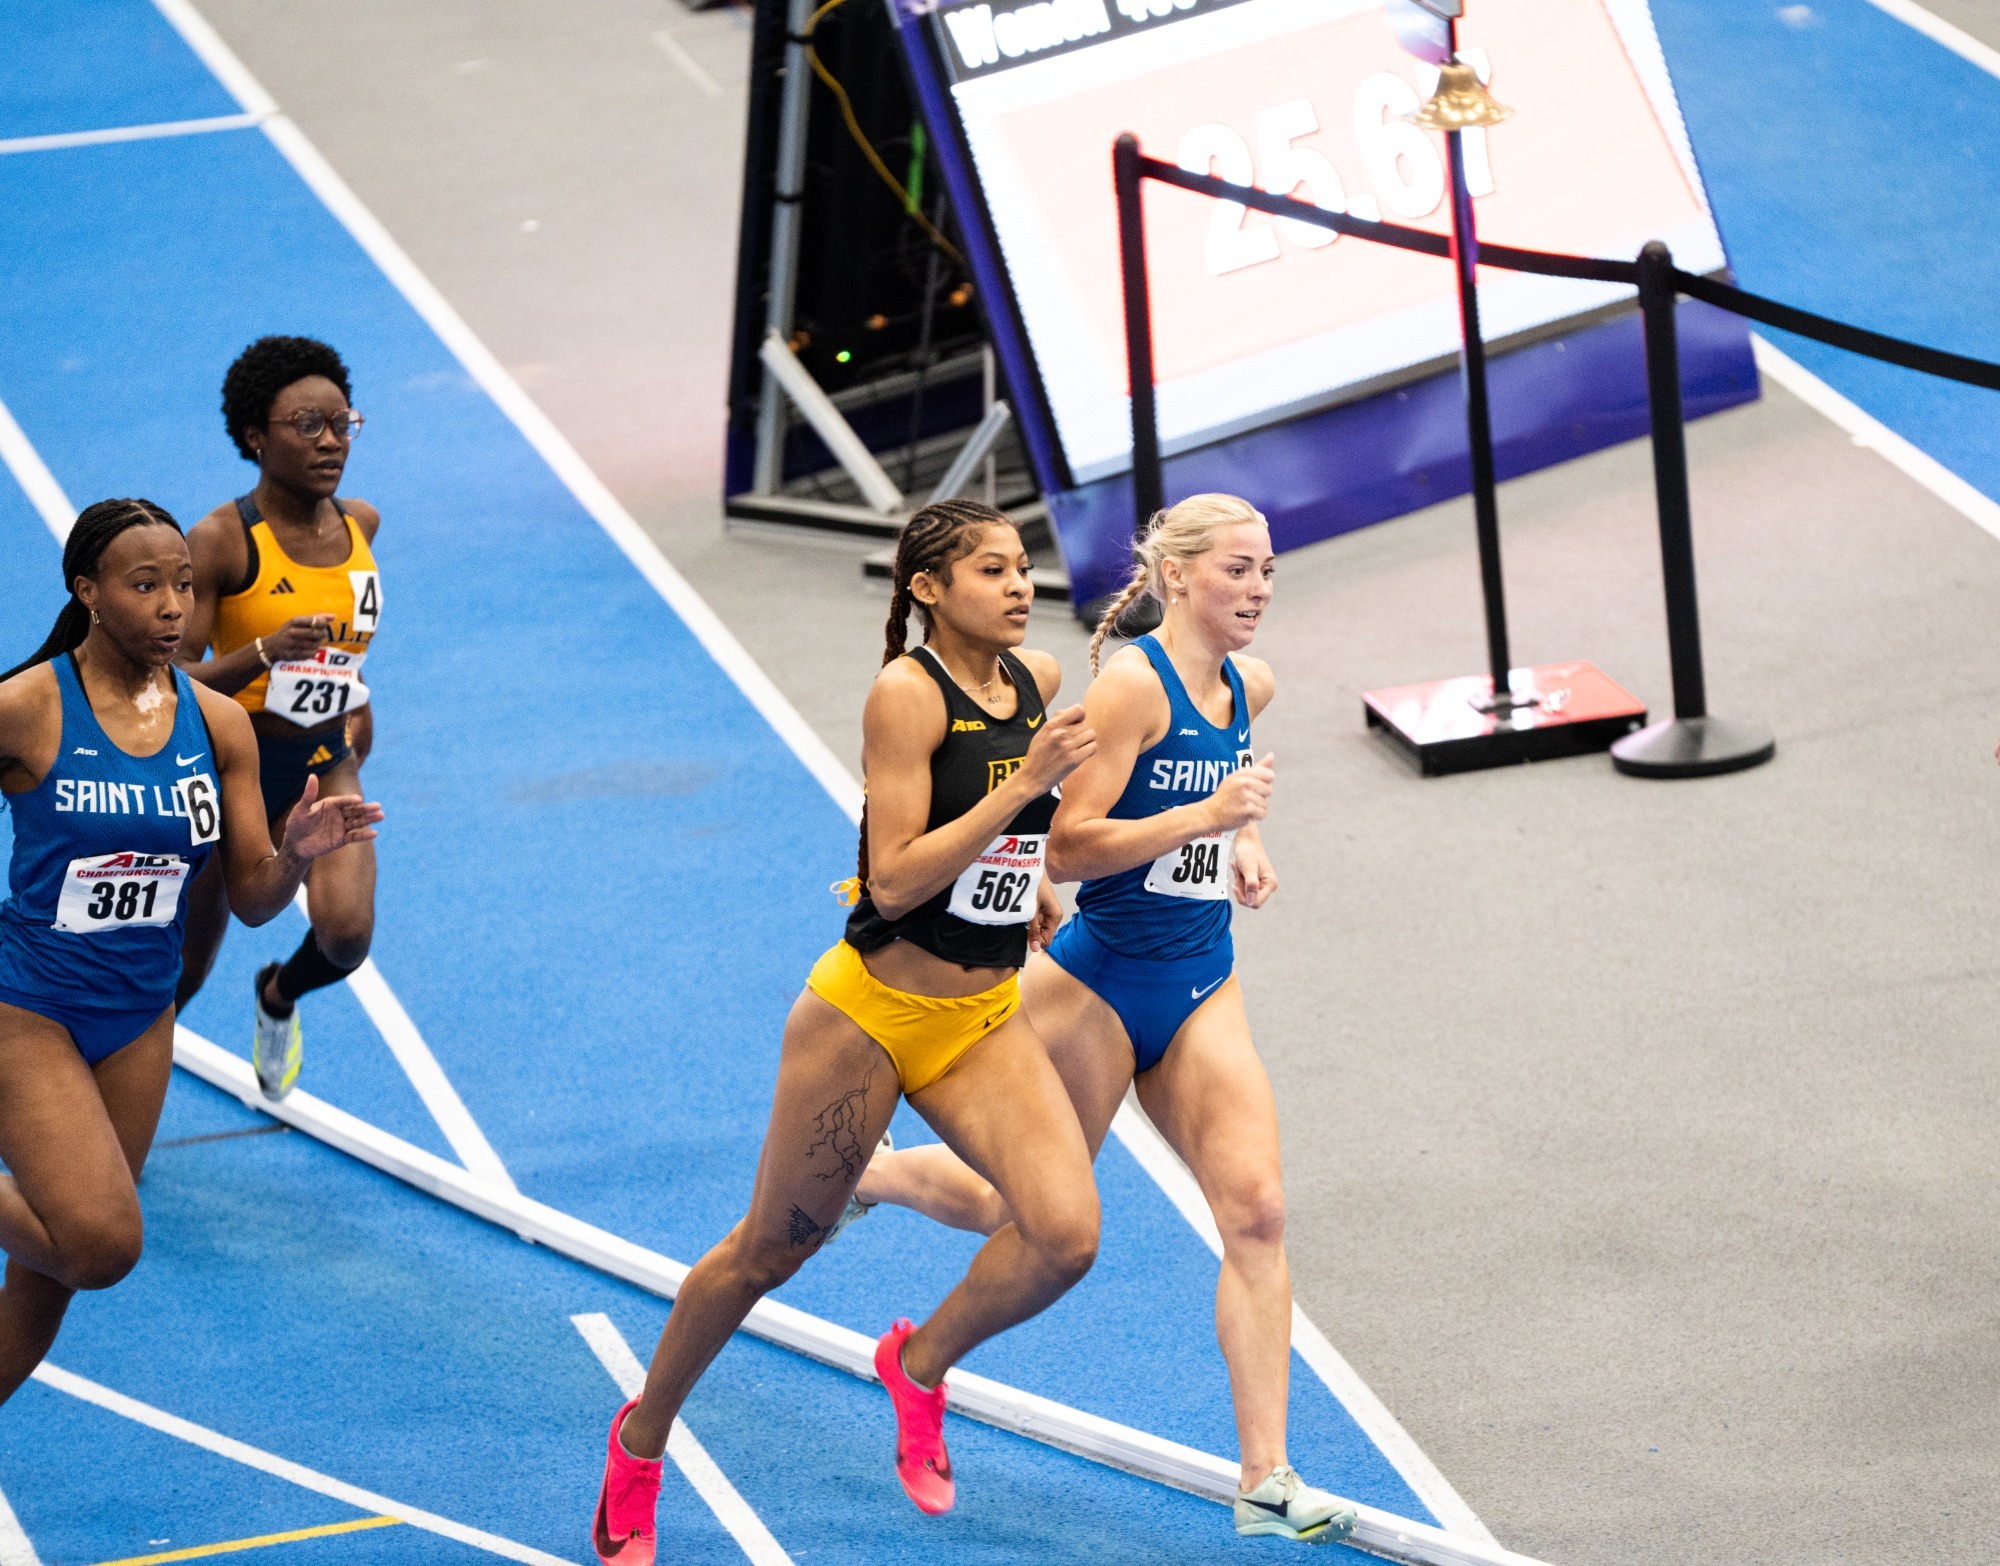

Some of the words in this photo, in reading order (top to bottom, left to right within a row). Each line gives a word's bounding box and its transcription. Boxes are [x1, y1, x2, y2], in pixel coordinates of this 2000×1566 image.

[1177, 47, 1494, 275] 25.67
[359, 576, 378, 627] 4
[290, 679, 350, 714] 231
[951, 719, 987, 732] A10
[73, 747, 98, 756] A10
[1150, 760, 1229, 792] SAINT
[55, 779, 145, 816] SAINT
[187, 780, 216, 839] 6
[98, 853, 170, 868] A10
[992, 837, 1038, 855] A10
[1172, 843, 1219, 884] 384
[76, 868, 180, 879] CHAMPIONSHIPS
[972, 870, 1030, 913] 562
[87, 880, 159, 920] 381
